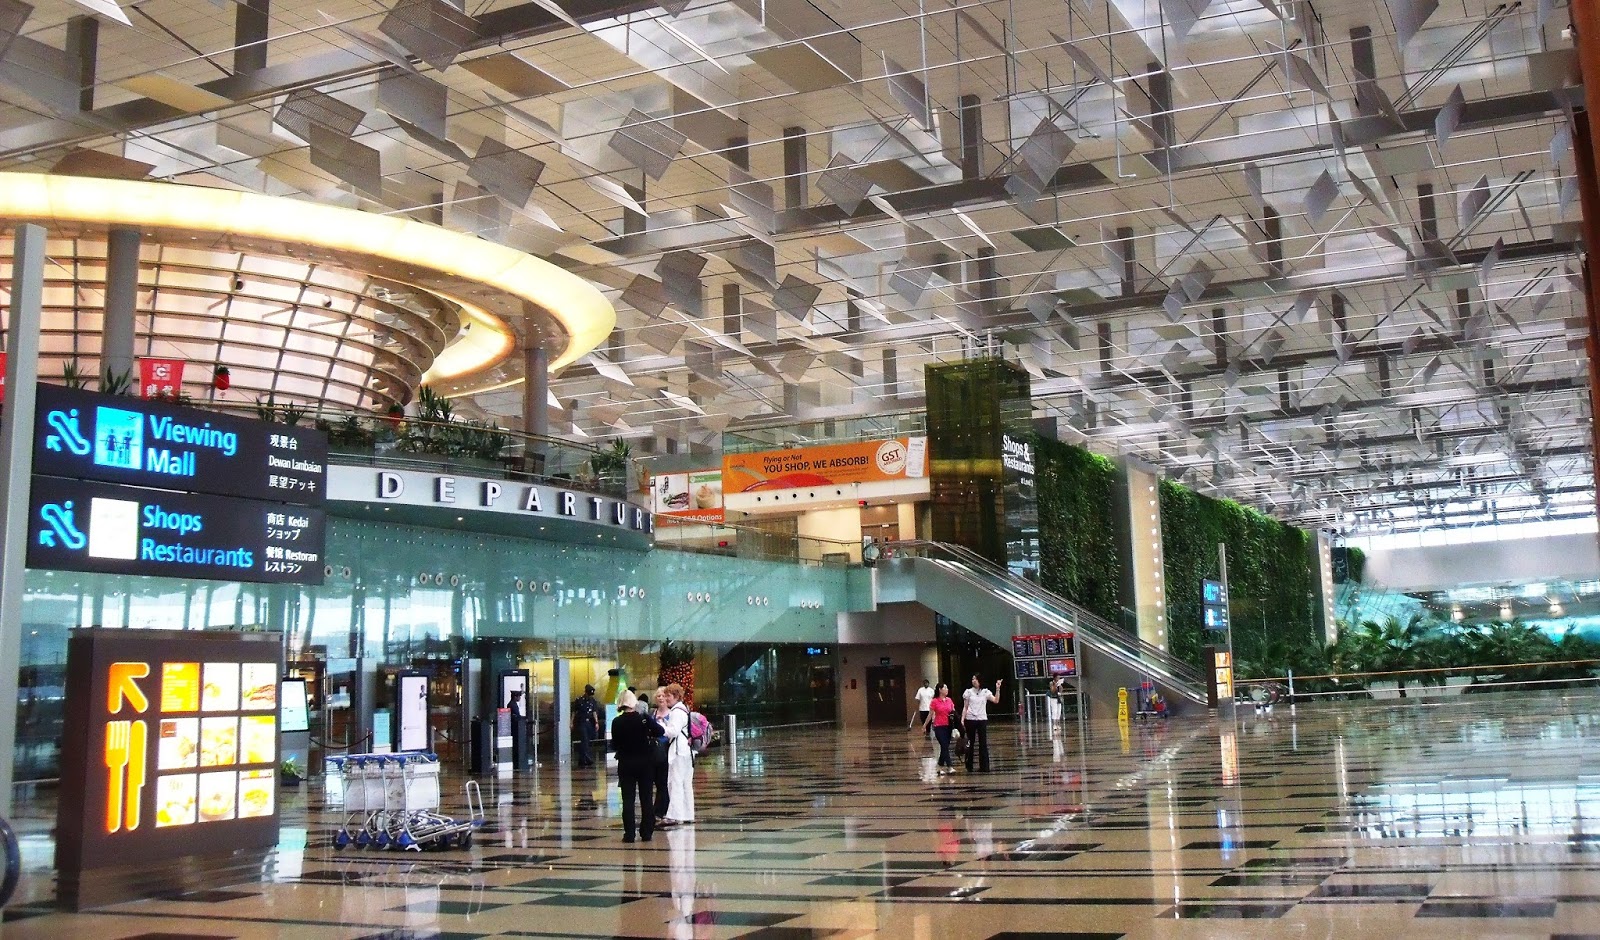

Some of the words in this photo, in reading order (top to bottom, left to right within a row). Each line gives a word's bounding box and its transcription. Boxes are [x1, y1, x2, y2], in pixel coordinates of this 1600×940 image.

[149, 414, 237, 456] Viewing
[269, 434, 298, 450] 观景台
[882, 449, 899, 461] GST
[1003, 434, 1023, 457] Shops
[1024, 442, 1030, 461] &
[146, 447, 196, 477] Mall
[269, 454, 291, 469] Dewan
[292, 458, 322, 473] Lambaian
[763, 456, 782, 465] Flying
[764, 464, 783, 474] YOU
[785, 461, 811, 472] SHOP,
[813, 459, 828, 469] WE
[830, 456, 869, 468] ABSORB!
[1003, 453, 1035, 475] Restaurants
[268, 474, 316, 492] 展望デッキ
[143, 504, 203, 536] Shops
[267, 512, 285, 526] 商店
[288, 515, 309, 528] Kedai
[267, 526, 301, 541] ショップ
[142, 537, 254, 568] Restaurants
[285, 549, 318, 562] Restoran
[265, 560, 302, 573] レストラン
